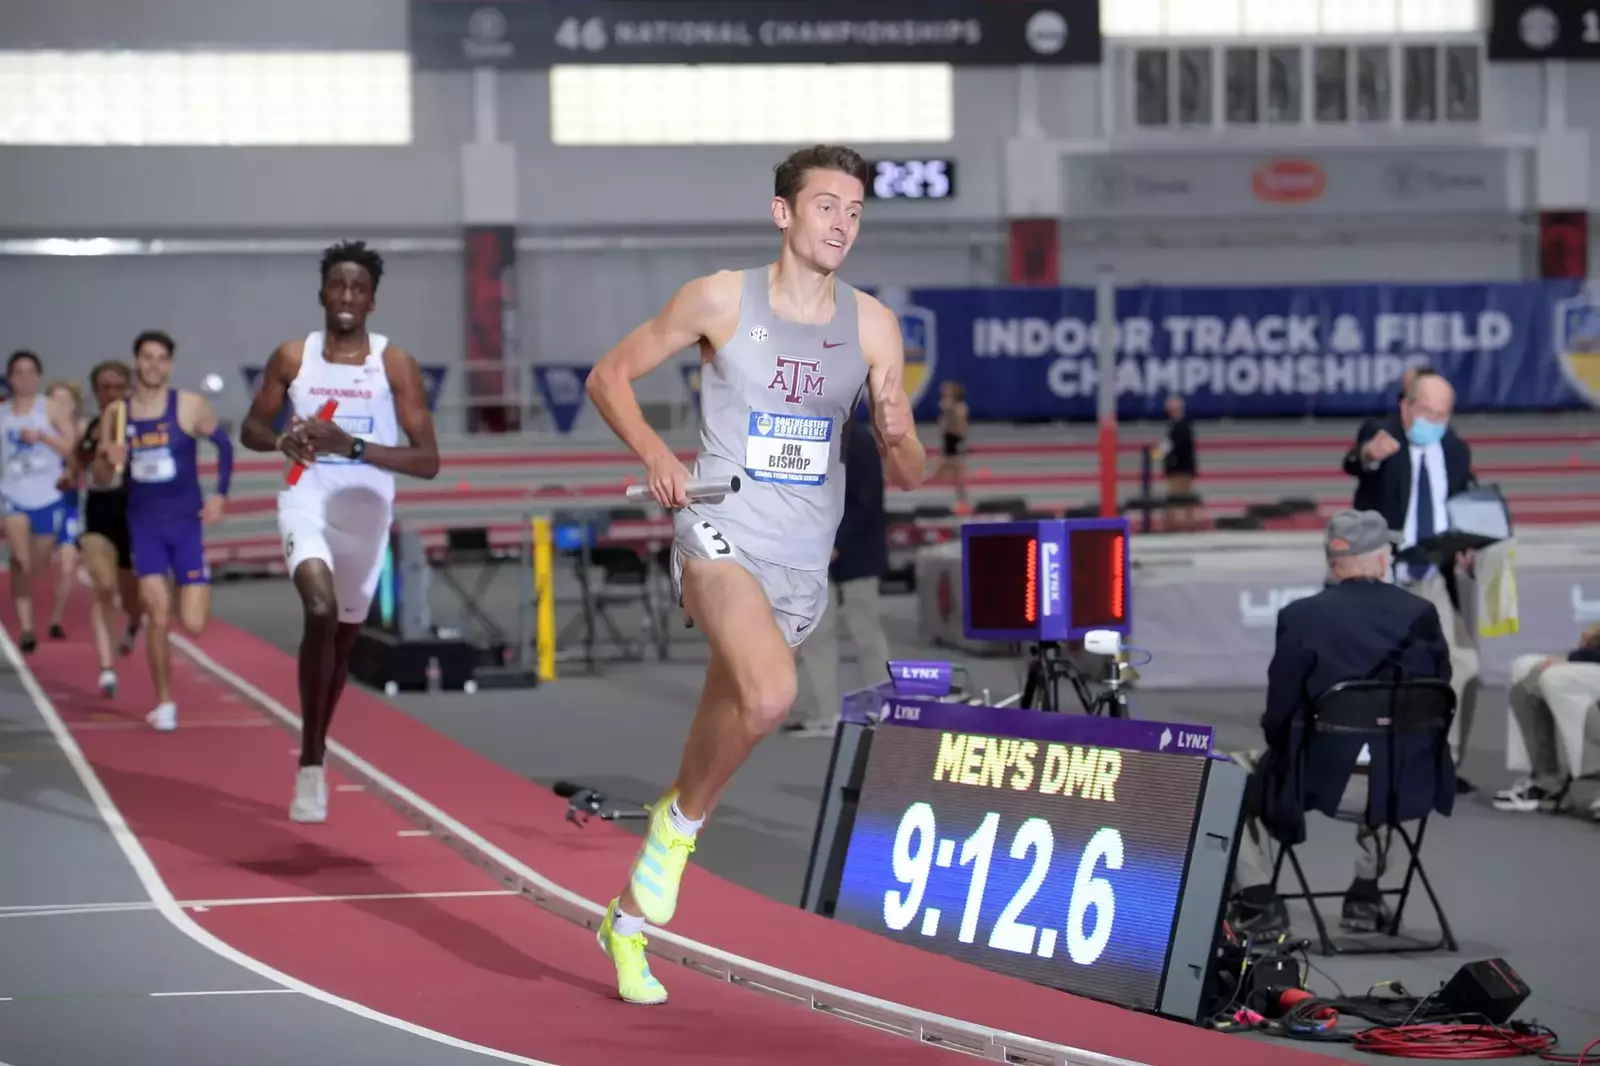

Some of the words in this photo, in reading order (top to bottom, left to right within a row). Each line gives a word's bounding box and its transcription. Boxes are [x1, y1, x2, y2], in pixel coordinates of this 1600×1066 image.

[554, 17, 607, 51] 46
[614, 20, 752, 46] NATIONAL
[759, 19, 982, 46] CHAMPIONSHIPS
[874, 160, 949, 198] 2:25
[1163, 315, 1319, 354] TRACK
[1331, 313, 1364, 350] &
[1375, 311, 1512, 351] FIELD
[773, 425, 828, 437] CONFERENCE
[774, 416, 829, 429] SOUTHEASTERN
[780, 443, 802, 456] JON
[768, 455, 811, 470] BISHOP
[702, 522, 731, 554] 3
[1050, 562, 1060, 600] LYNX
[902, 666, 939, 679] LYNX
[894, 704, 921, 720] LYNX
[1177, 731, 1210, 749] LYNX
[933, 732, 1039, 791] MEN'S
[1039, 743, 1122, 802] DMR
